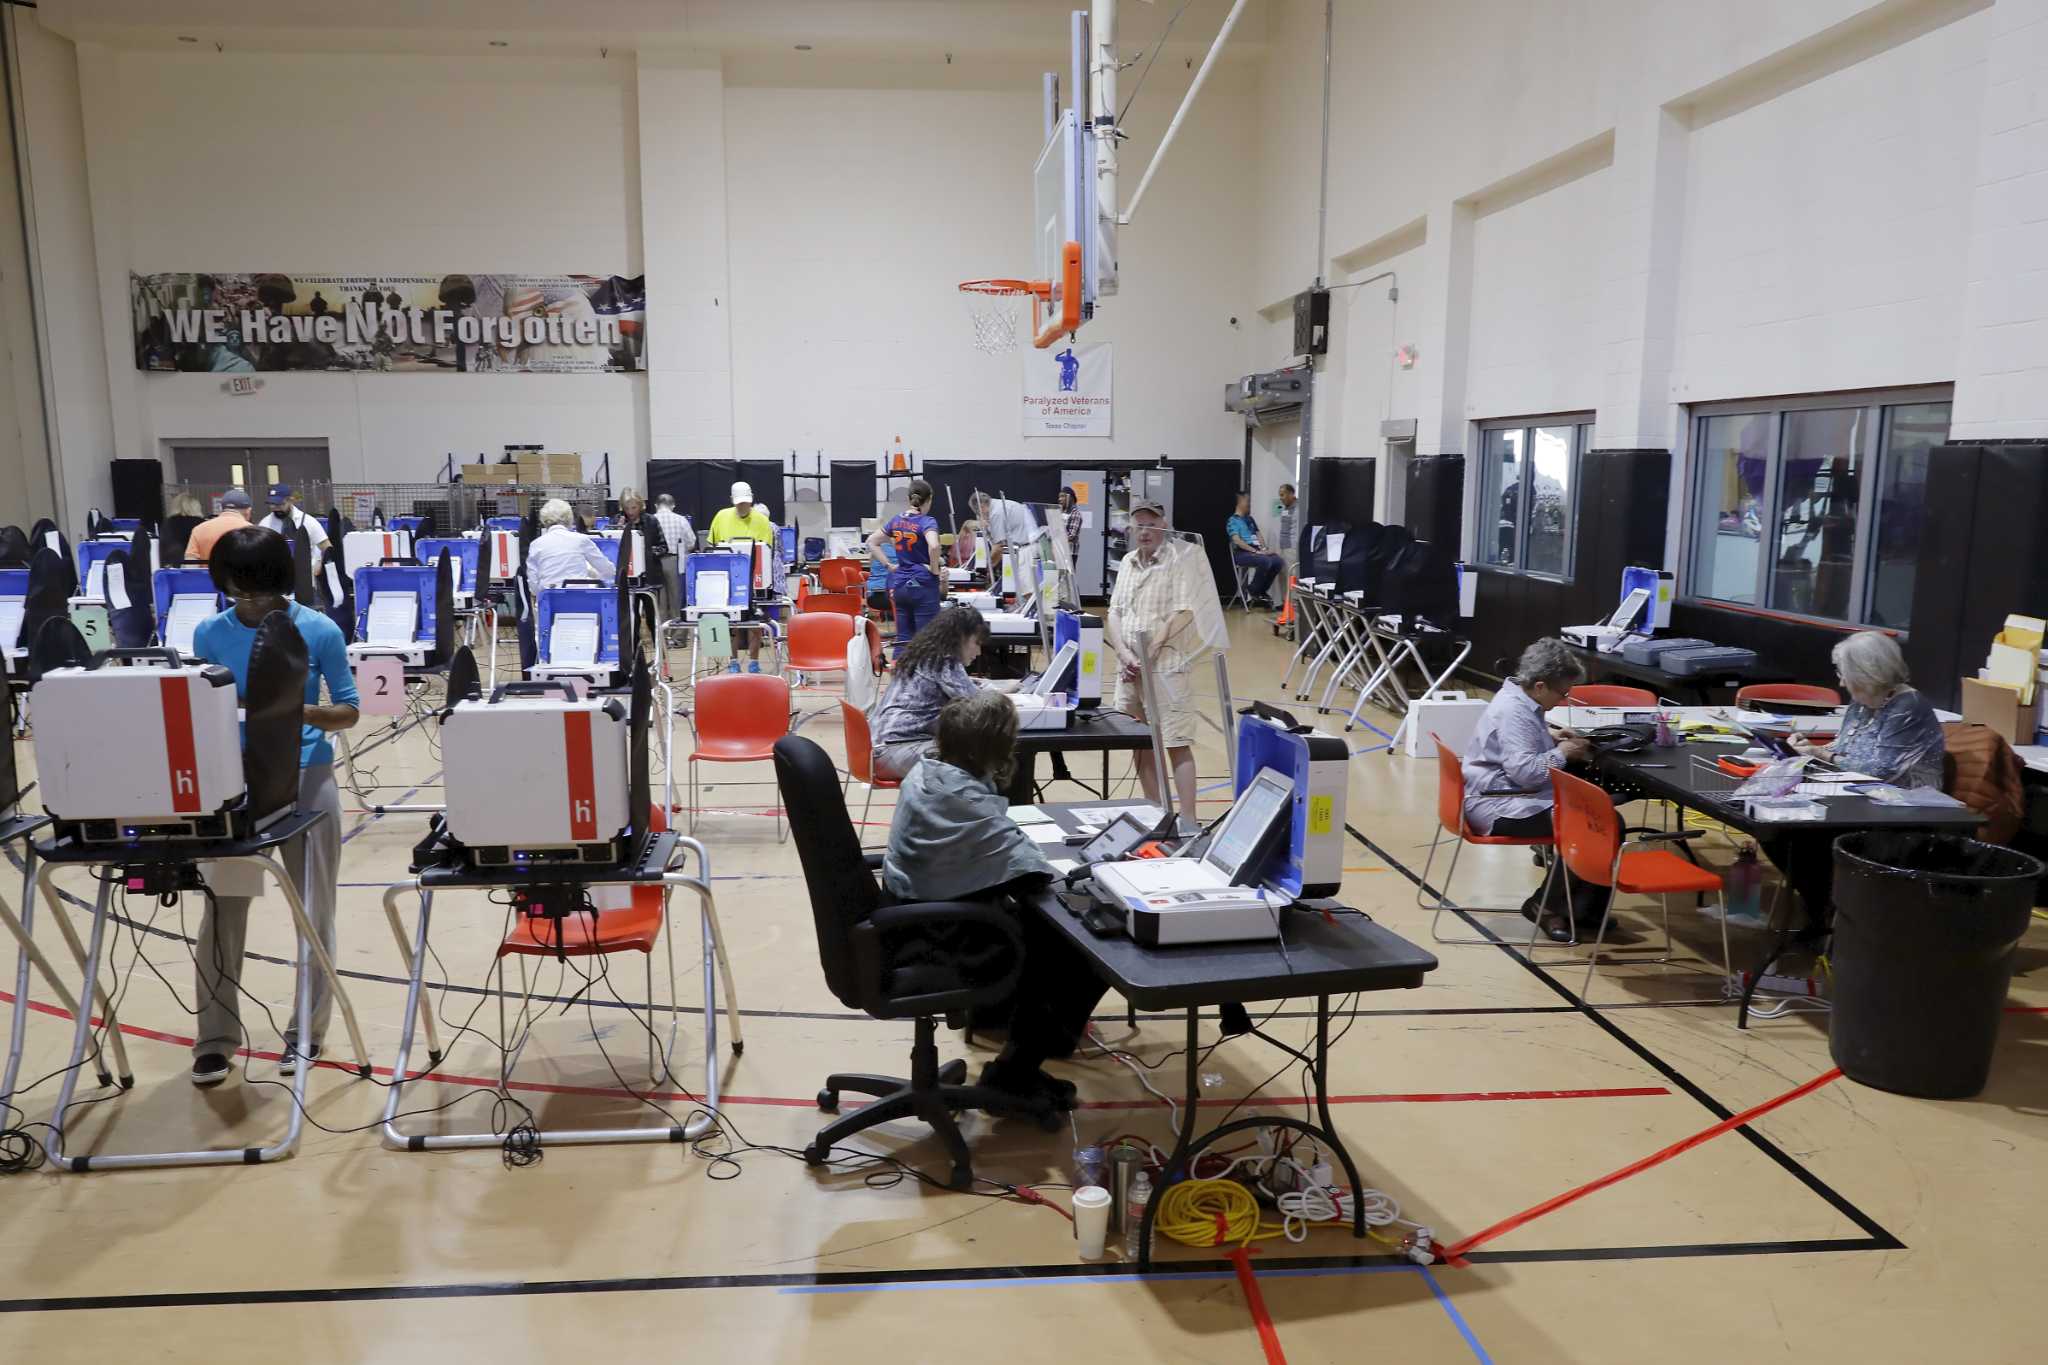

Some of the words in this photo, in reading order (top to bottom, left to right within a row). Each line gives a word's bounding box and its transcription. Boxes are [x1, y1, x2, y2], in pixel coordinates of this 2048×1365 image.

[164, 309, 228, 343] WE
[241, 309, 337, 344] Have
[345, 301, 426, 344] Not
[434, 309, 621, 348] Forgotten
[233, 377, 253, 392] EXIT
[1024, 396, 1068, 406] Paralyzed
[1071, 396, 1110, 405] Veterans
[1042, 407, 1051, 416] of
[1053, 407, 1091, 416] America
[893, 530, 918, 552] 27
[86, 620, 97, 636] 5
[711, 627, 720, 642] 1
[375, 675, 388, 695] 2
